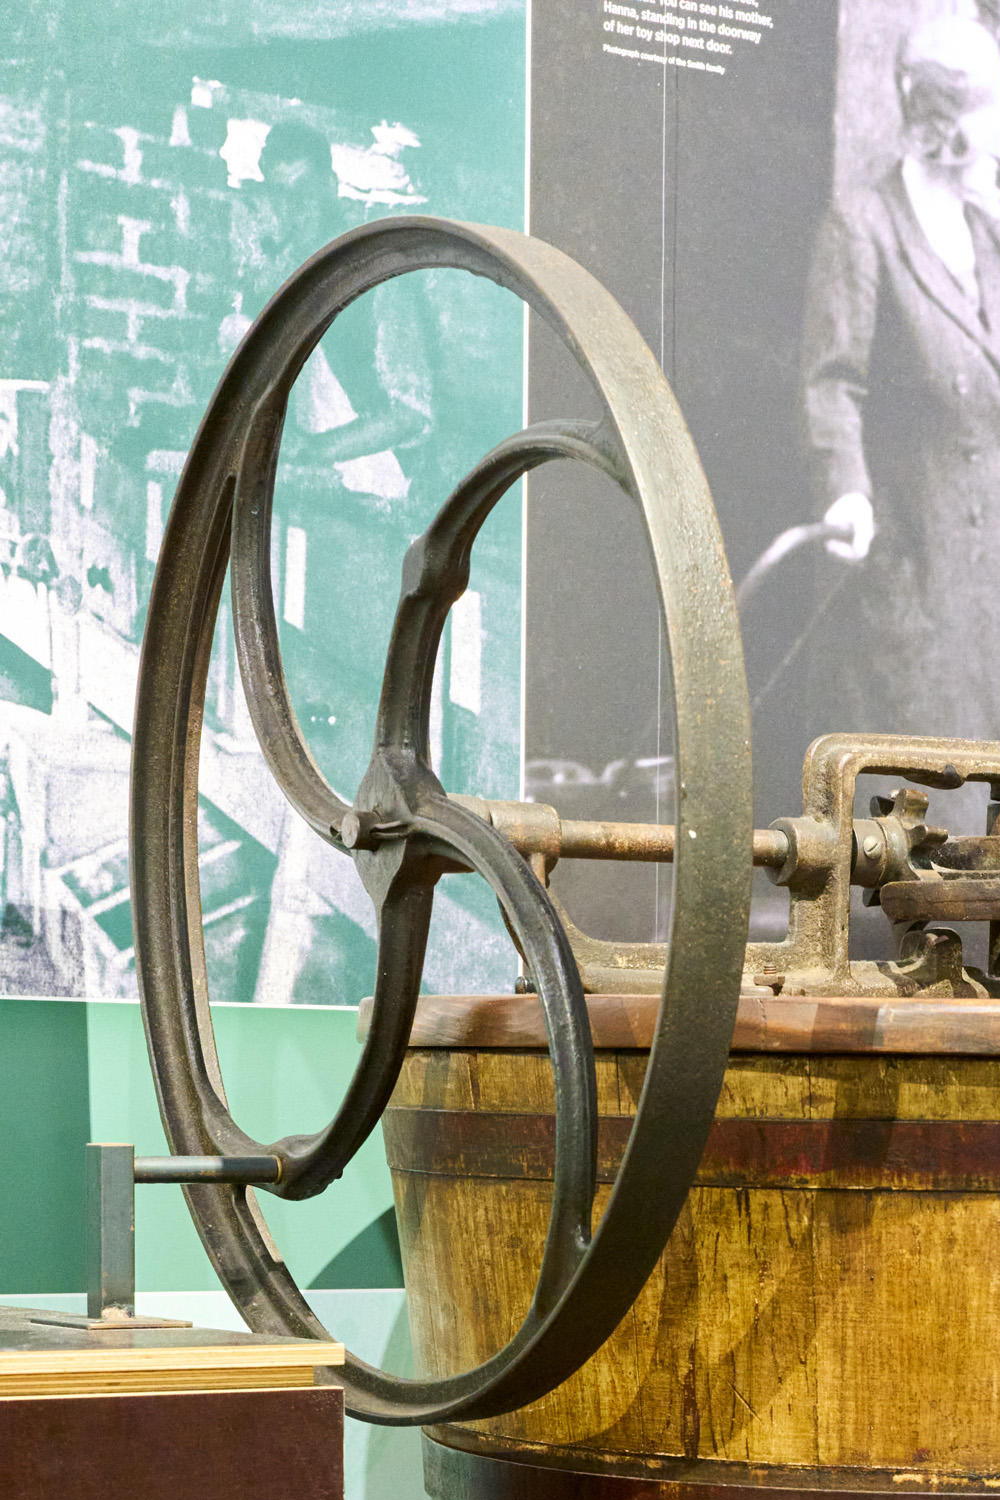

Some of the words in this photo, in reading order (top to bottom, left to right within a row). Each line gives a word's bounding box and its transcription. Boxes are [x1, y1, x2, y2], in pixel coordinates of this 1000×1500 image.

[603, 1, 639, 20] Hanna,
[641, 10, 686, 29] standing
[687, 17, 698, 30] in
[699, 20, 716, 33] the
[718, 23, 762, 44] doorway
[679, 0, 698, 11] can
[699, 3, 717, 16] see
[718, 5, 734, 19] his
[735, 10, 774, 29] mother,
[603, 20, 615, 32] of
[616, 21, 634, 36] her
[636, 25, 653, 41] toy
[655, 30, 680, 46] shop
[682, 36, 705, 49] next
[706, 39, 733, 55] door.
[668, 57, 676, 65] of
